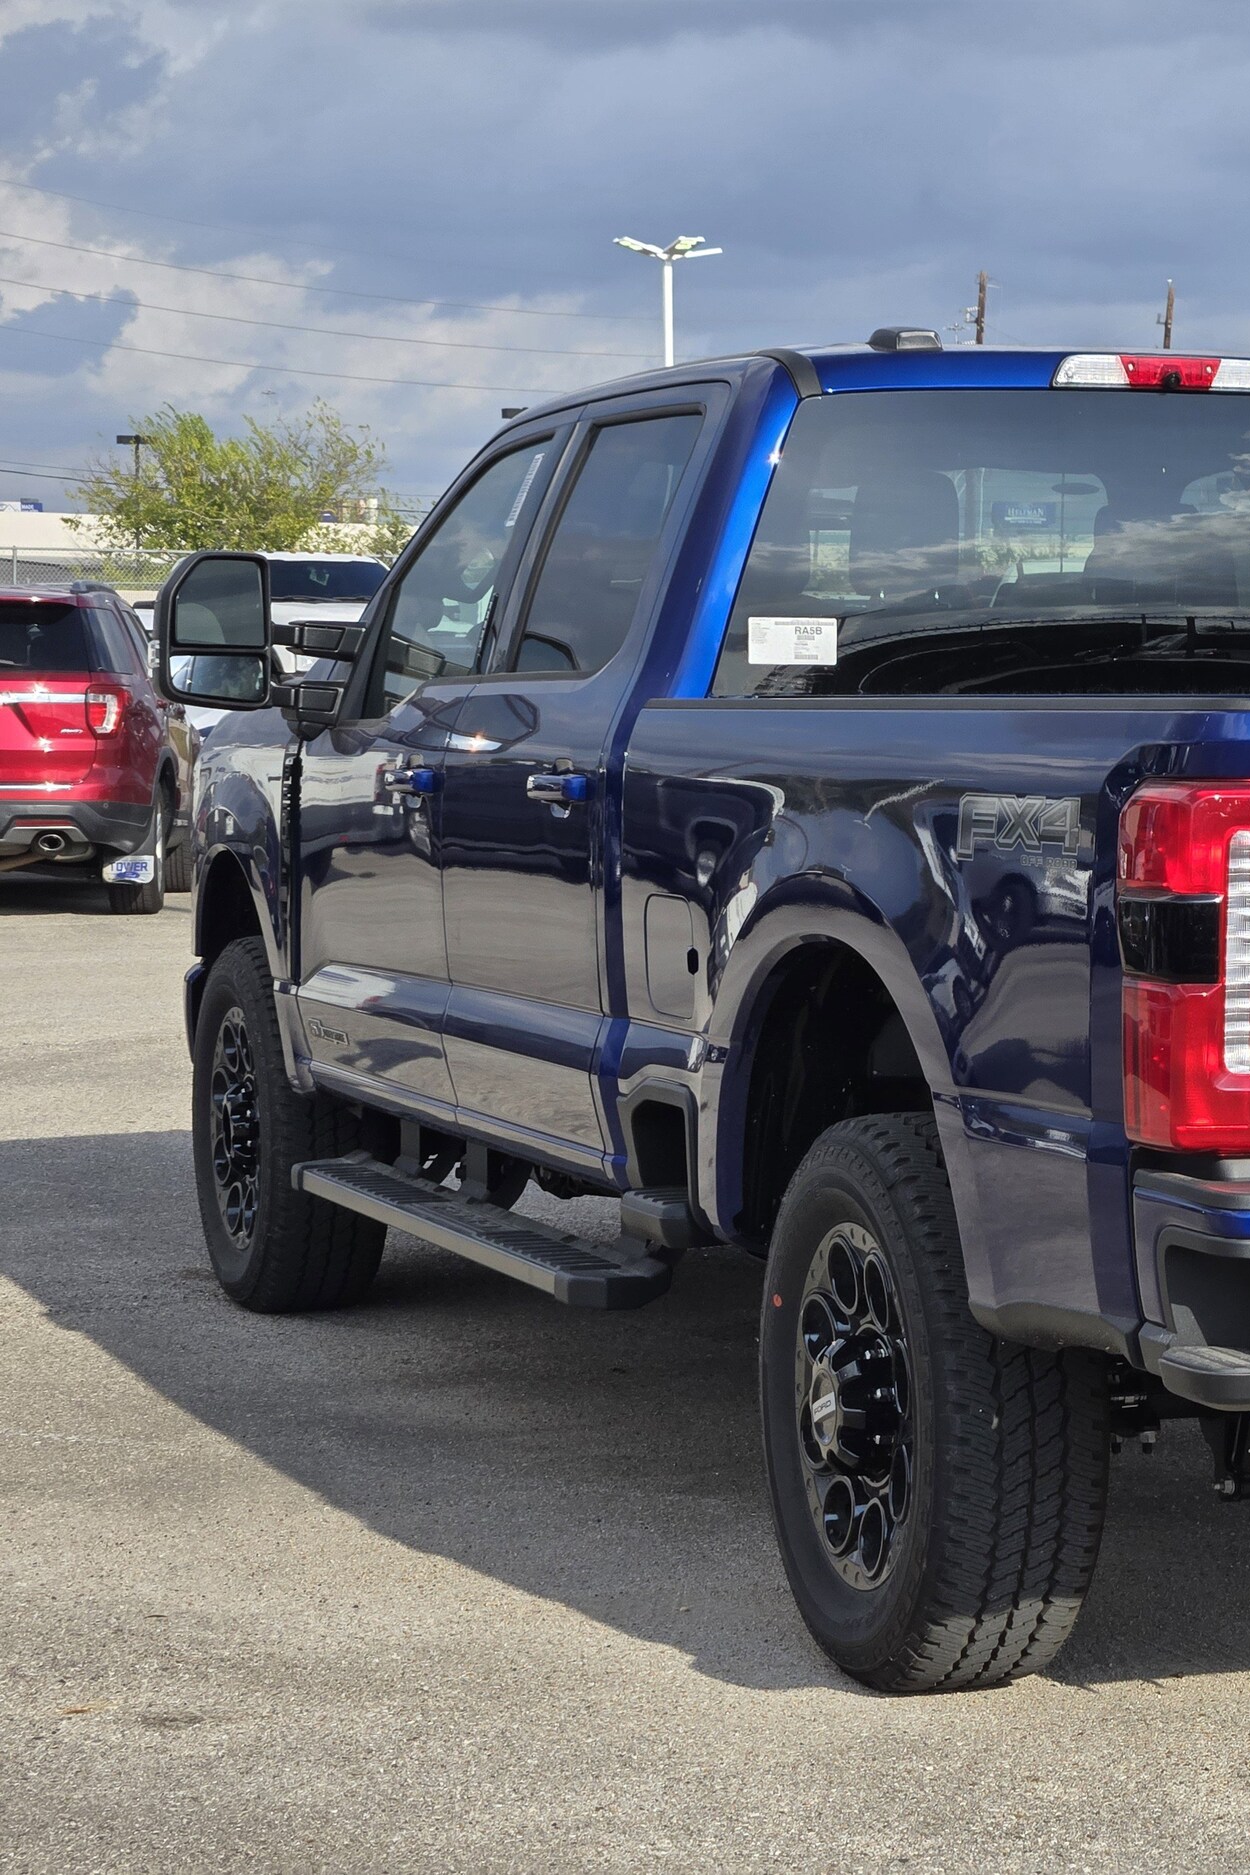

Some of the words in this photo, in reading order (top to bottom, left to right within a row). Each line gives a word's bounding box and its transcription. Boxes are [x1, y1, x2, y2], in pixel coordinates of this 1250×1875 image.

[1007, 507, 1044, 516] HELFMAN
[795, 626, 823, 635] RA5B
[956, 792, 1081, 862] FX4
[1020, 854, 1043, 867] OFF
[813, 1399, 832, 1414] FORD
